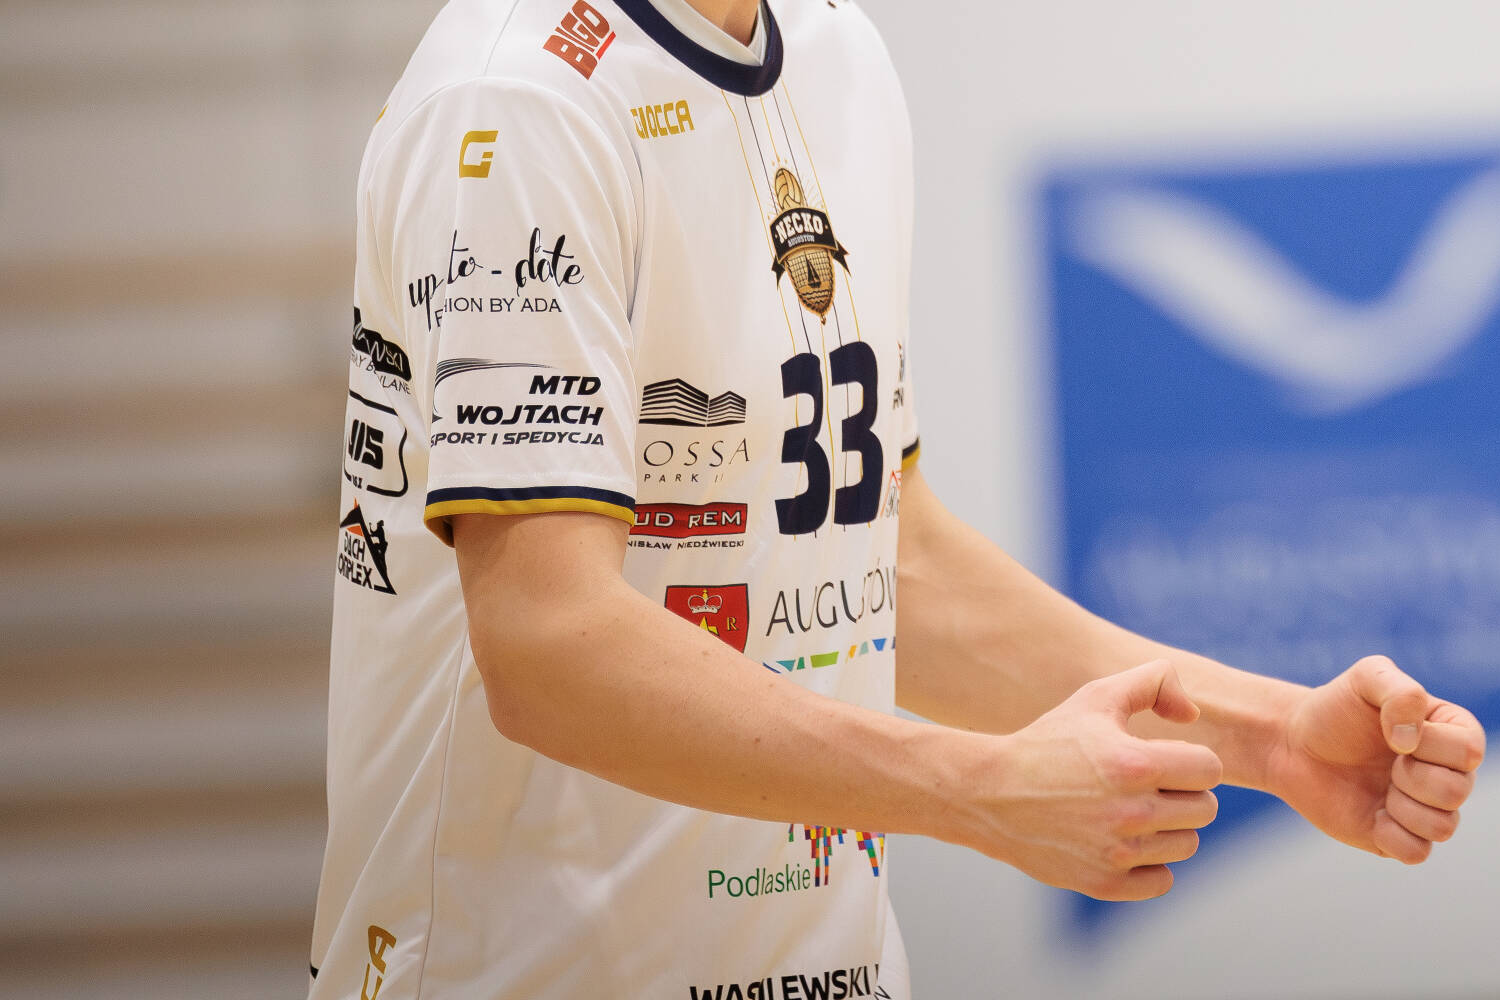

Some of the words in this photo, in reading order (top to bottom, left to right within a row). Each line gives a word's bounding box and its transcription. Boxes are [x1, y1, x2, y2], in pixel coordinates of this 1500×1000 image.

[543, 0, 610, 80] BIGO
[775, 212, 824, 244] NECKO
[408, 273, 444, 332] up
[447, 229, 484, 284] to
[515, 226, 585, 297] date
[490, 298, 514, 312] BY
[521, 298, 562, 312] ADA
[529, 375, 602, 395] MTD
[457, 404, 604, 425] WOJTACH
[491, 433, 499, 445] I
[502, 431, 604, 445] SPEDYCJA
[775, 341, 884, 535] 33
[643, 473, 699, 483] PARK
[688, 510, 742, 529] REM
[726, 616, 738, 631] R
[708, 863, 812, 899] Podlaskie
